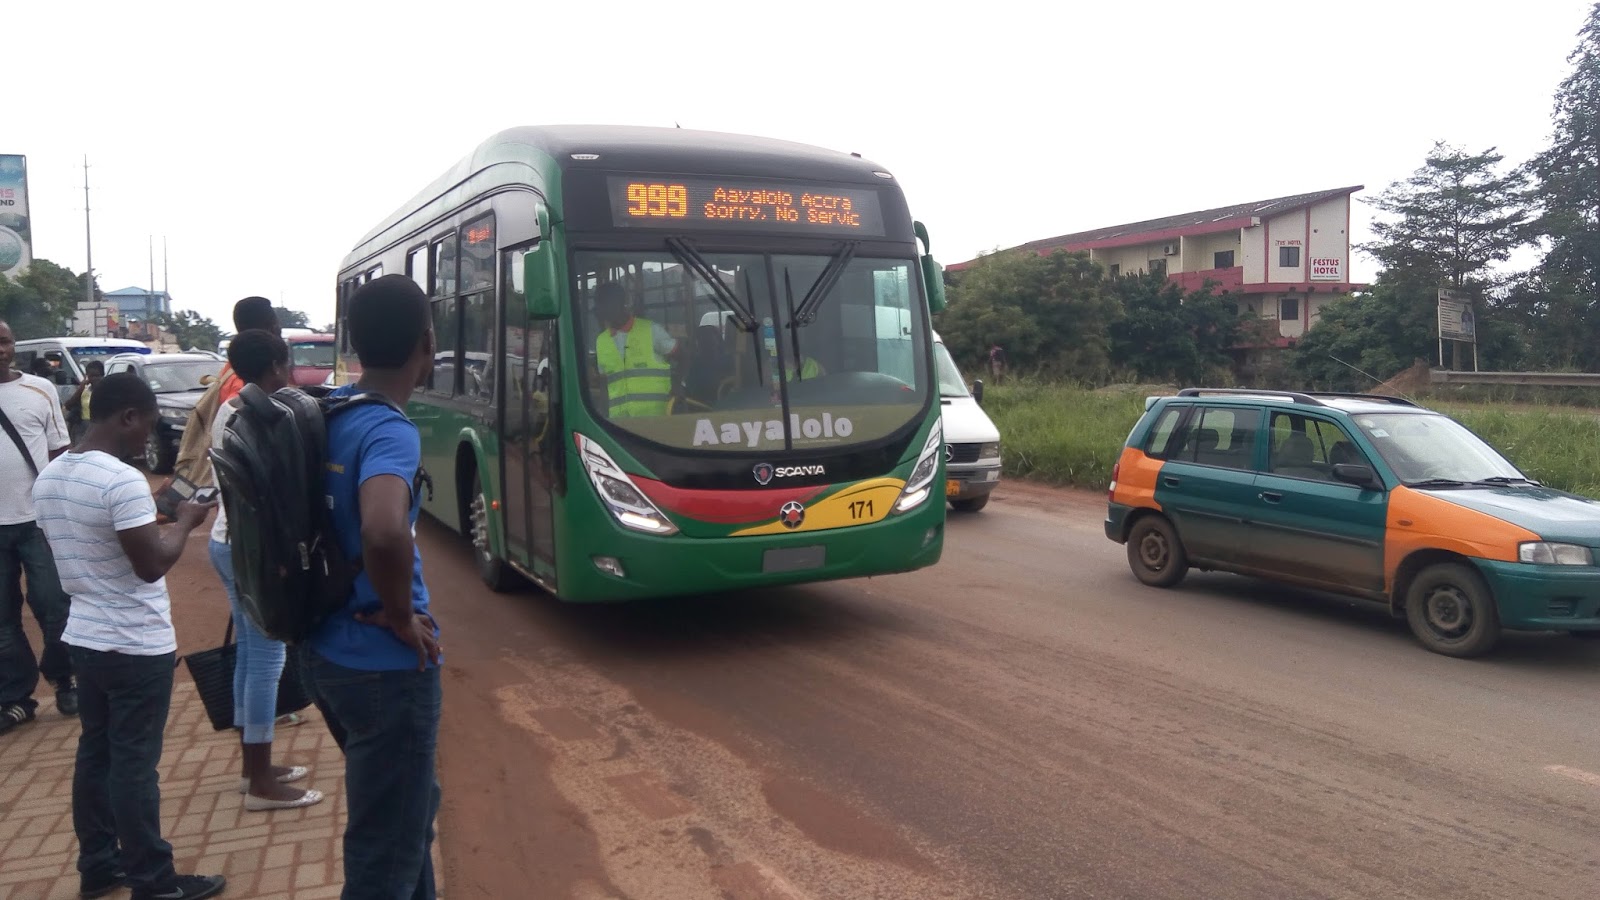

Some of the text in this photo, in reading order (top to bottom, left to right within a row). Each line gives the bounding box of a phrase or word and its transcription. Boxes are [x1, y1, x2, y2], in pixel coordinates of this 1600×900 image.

[627, 184, 687, 217] 999
[714, 187, 852, 210] Aayalolo Accra
[704, 203, 860, 226] Sorry, No Servic
[692, 412, 853, 448] Aayalolo
[774, 464, 826, 478] SCANIA
[848, 499, 874, 519] 171
